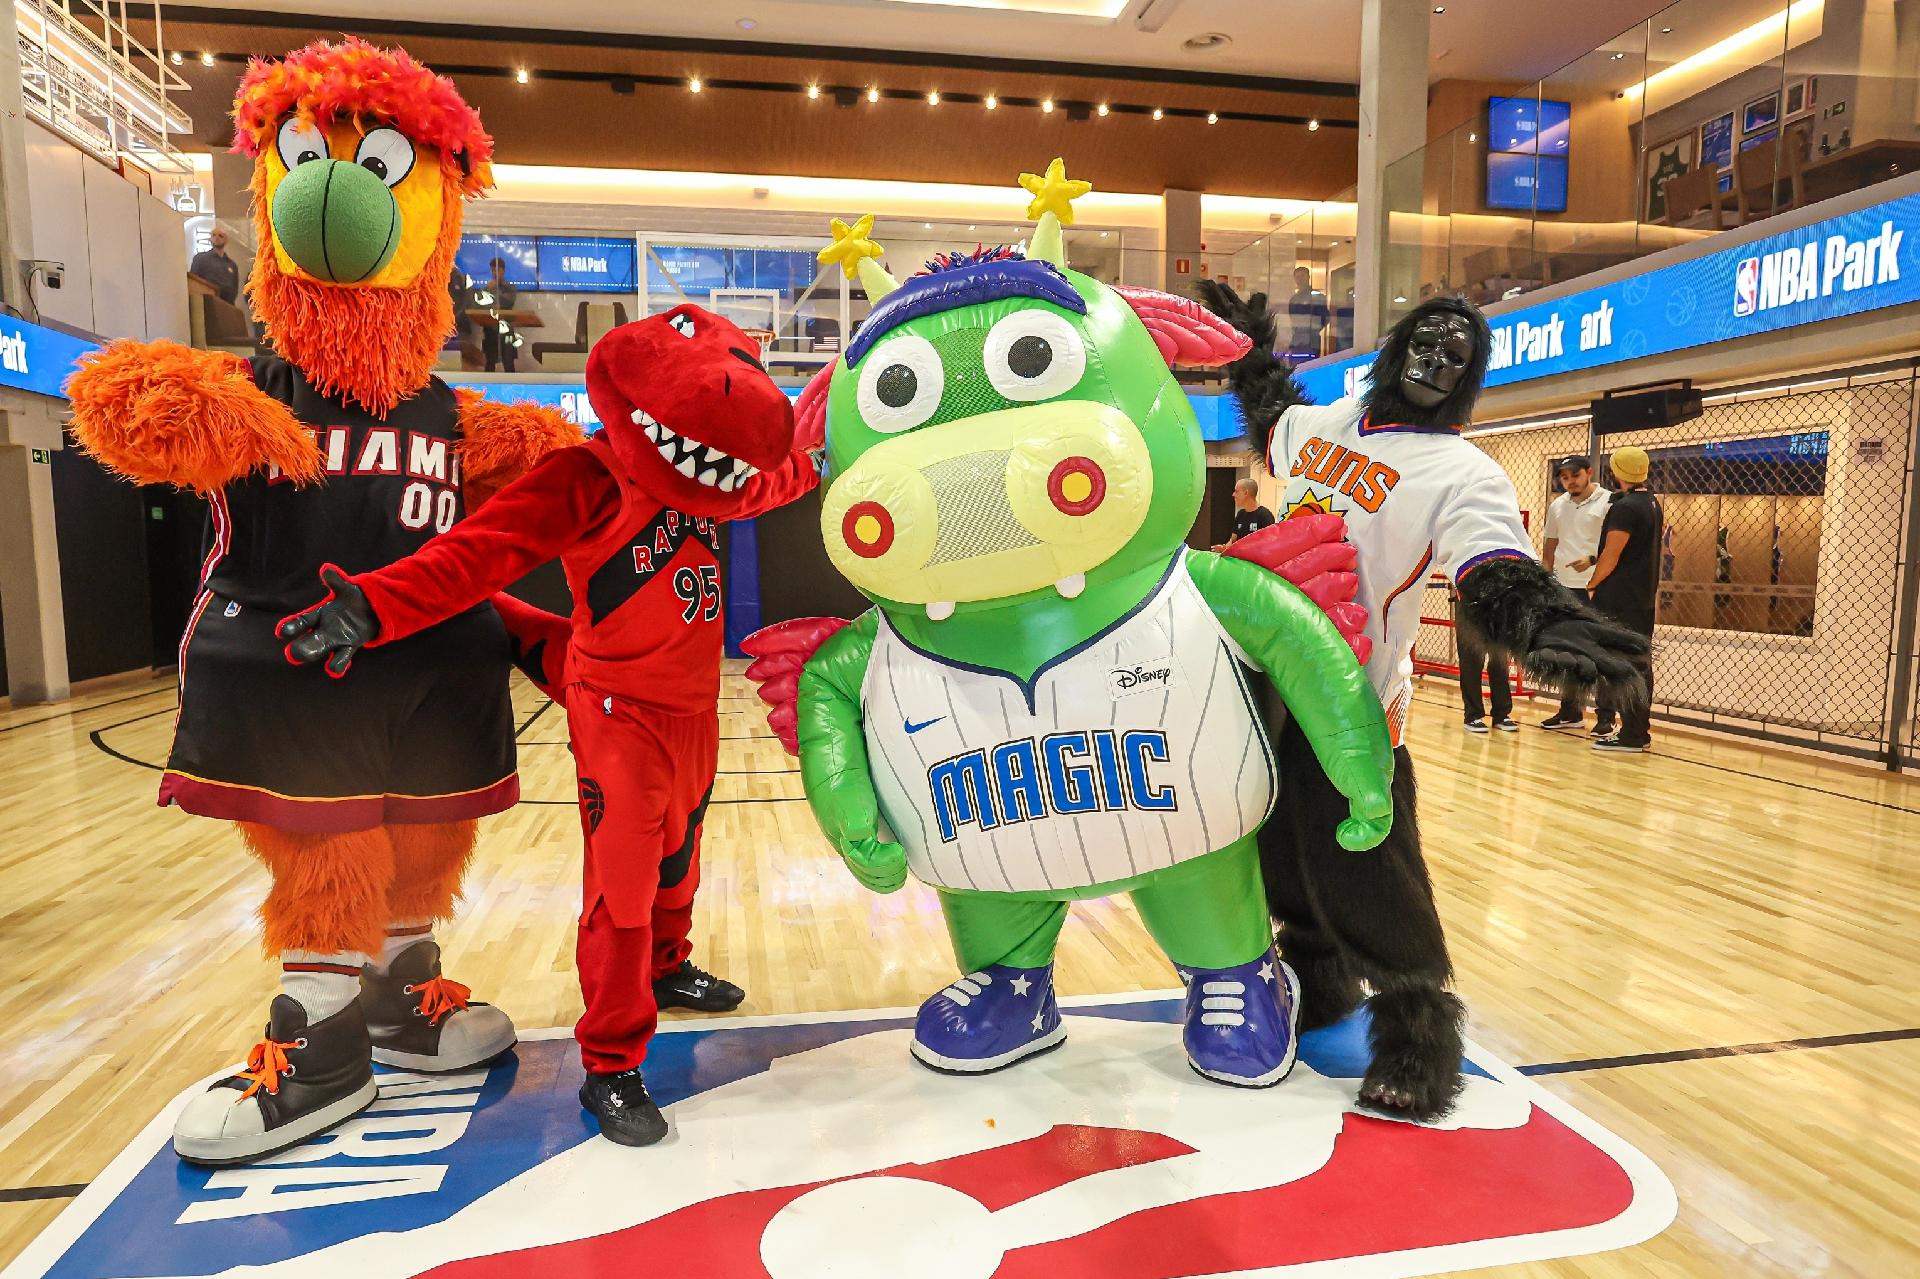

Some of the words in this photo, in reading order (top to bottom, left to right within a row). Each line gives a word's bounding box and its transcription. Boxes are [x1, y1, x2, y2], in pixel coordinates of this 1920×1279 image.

[570, 256, 587, 272] NBA
[587, 257, 608, 273] Park
[1759, 241, 1818, 310] NBA
[1822, 221, 1904, 297] Park
[0, 328, 29, 374] ark
[1515, 312, 1565, 365] Park
[1580, 299, 1614, 351] ark
[1290, 436, 1400, 514] SUNS
[399, 479, 457, 535] 00
[673, 565, 721, 625] 95
[927, 729, 1178, 843] MAGIC
